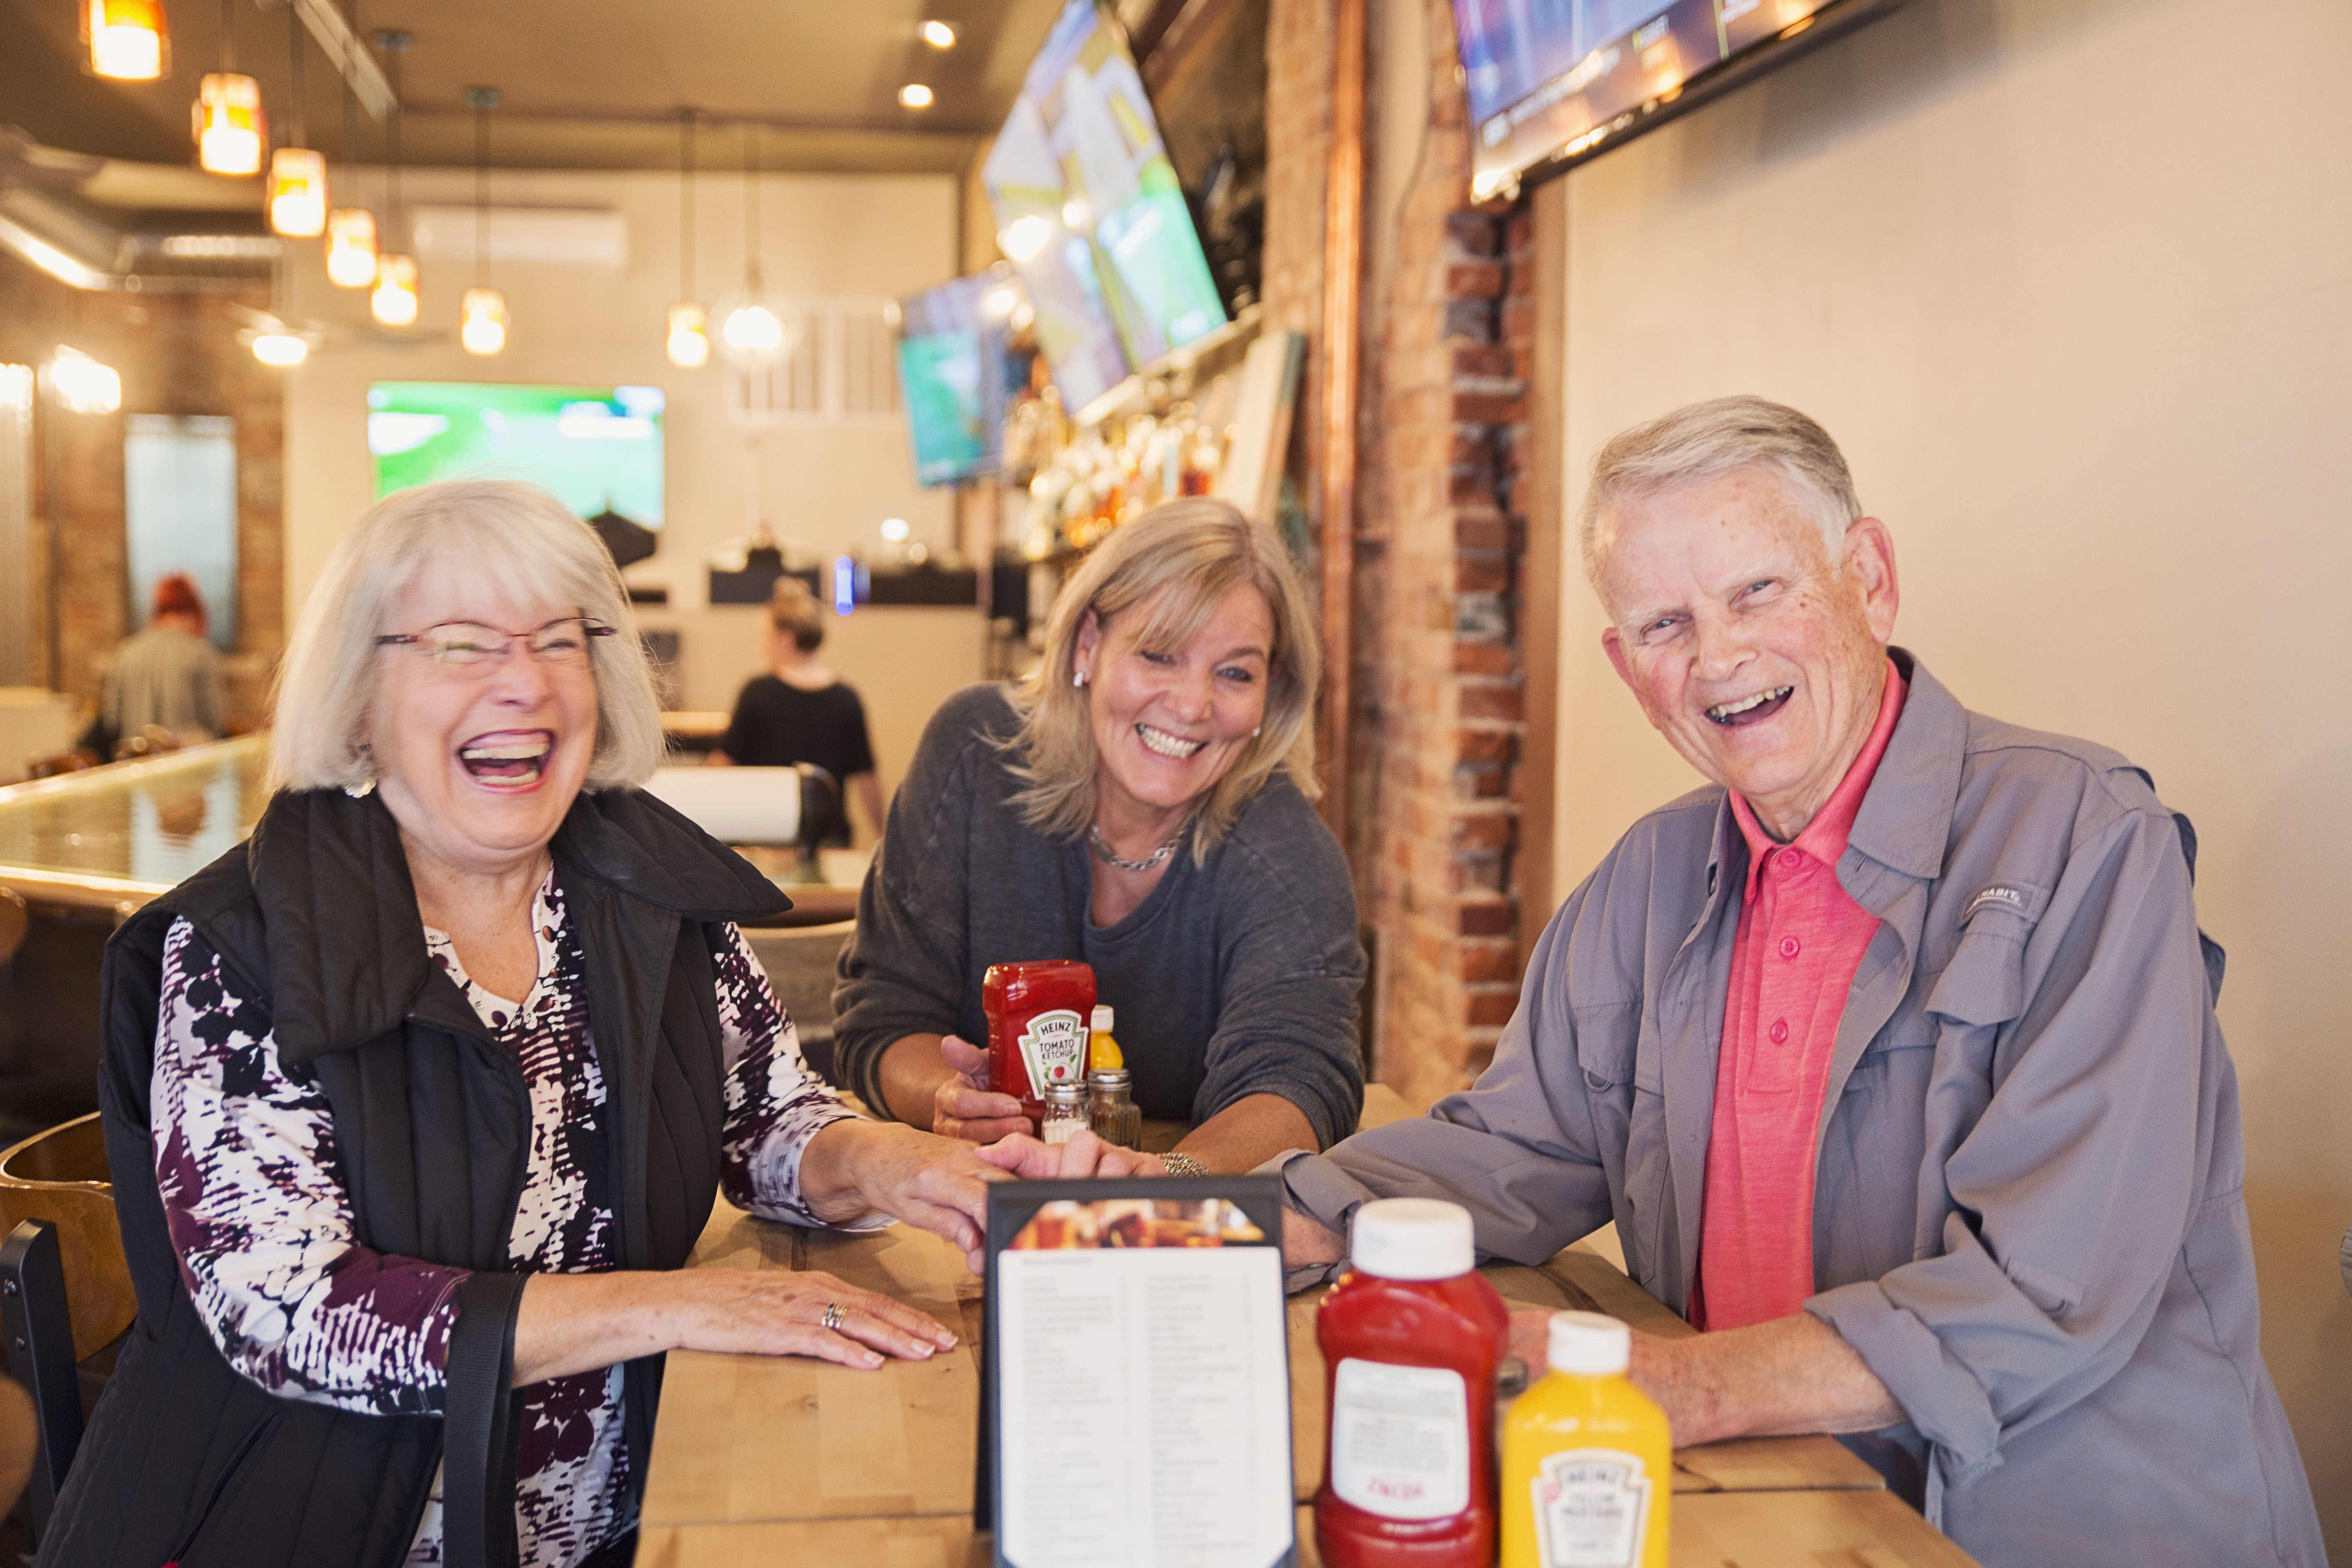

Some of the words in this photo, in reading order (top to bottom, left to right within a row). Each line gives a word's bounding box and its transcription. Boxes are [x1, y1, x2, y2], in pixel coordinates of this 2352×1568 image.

[1041, 1021, 1071, 1036] HEINZ
[1039, 1039, 1074, 1052] TOMATO
[1042, 1049, 1073, 1060] KETCHUP
